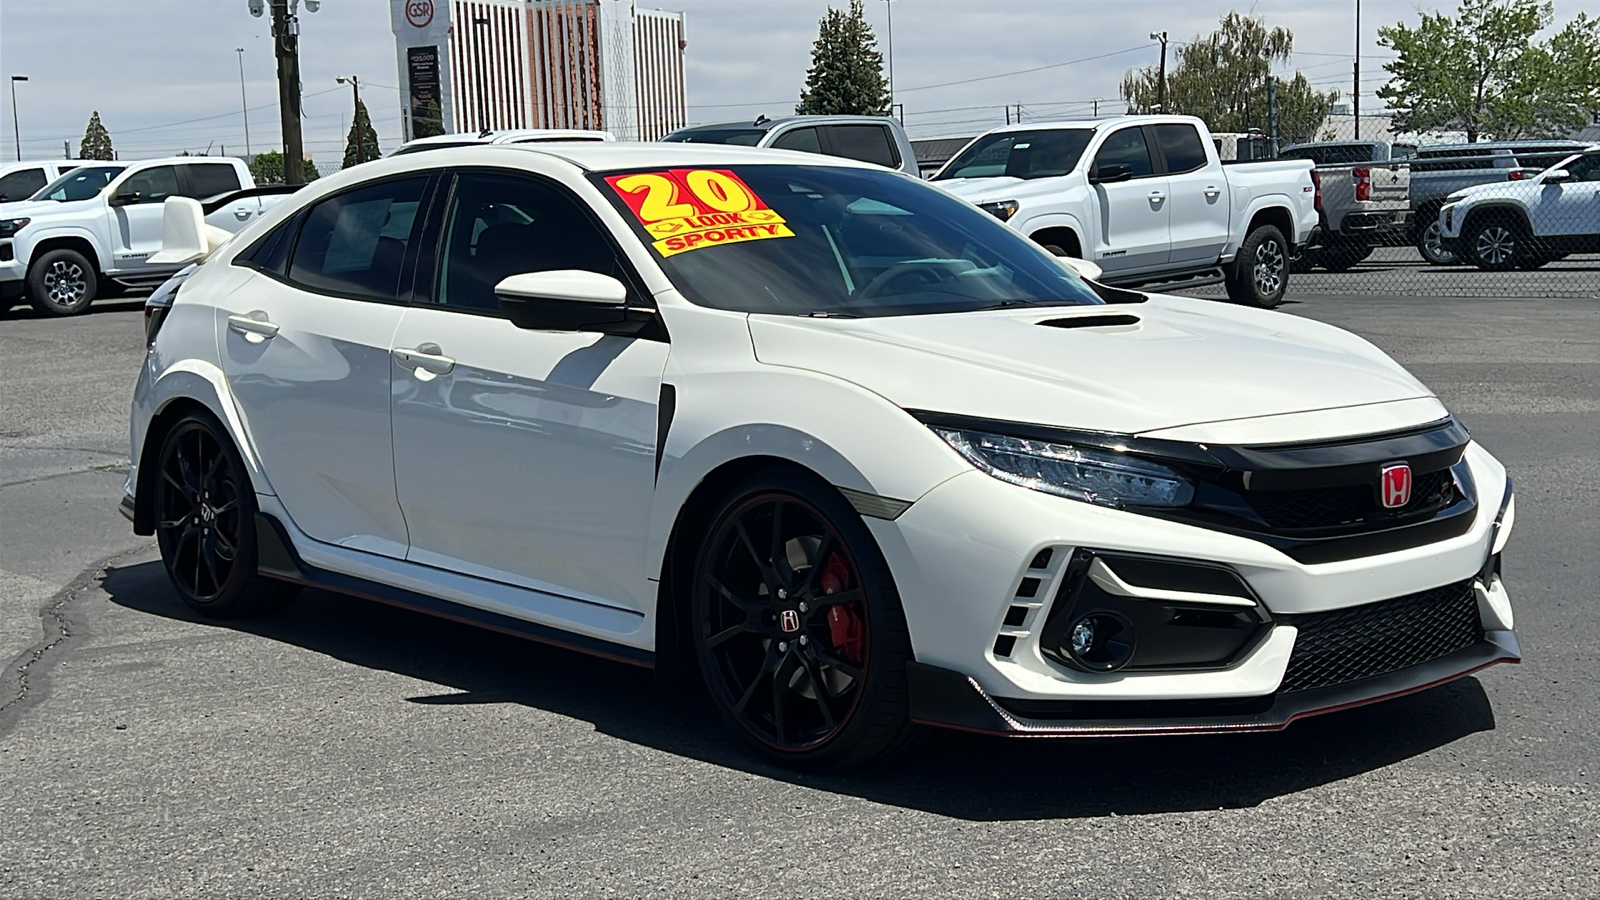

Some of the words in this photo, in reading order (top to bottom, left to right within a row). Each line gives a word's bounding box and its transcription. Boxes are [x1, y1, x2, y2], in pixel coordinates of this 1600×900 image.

[409, 2, 429, 17] GSR
[616, 170, 755, 222] 20
[683, 212, 746, 229] LOOK
[665, 224, 778, 251] SPORTY
